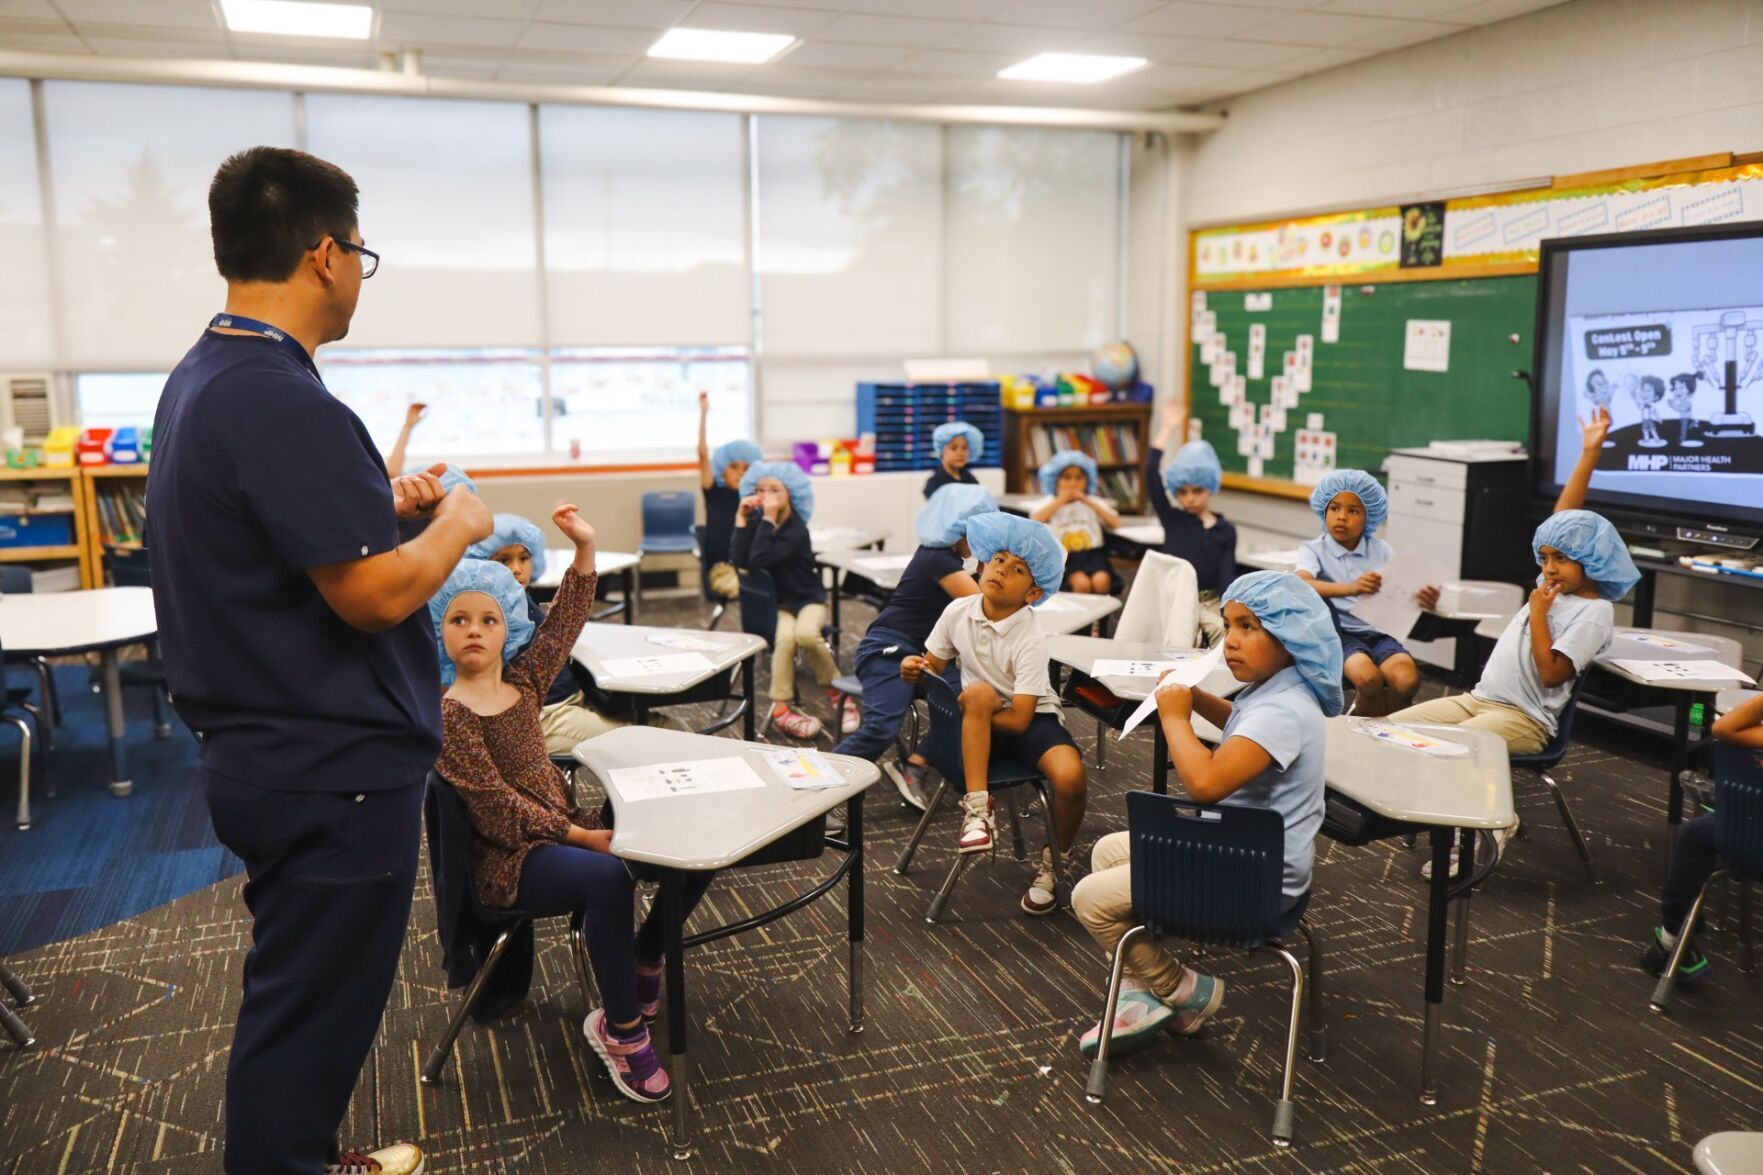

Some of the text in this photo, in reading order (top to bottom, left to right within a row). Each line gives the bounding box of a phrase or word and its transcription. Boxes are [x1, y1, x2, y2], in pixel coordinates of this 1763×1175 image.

[1591, 330, 1661, 345] Contest Open
[1628, 454, 1668, 470] MHP
[1673, 455, 1731, 464] MAJOR HEALTH
